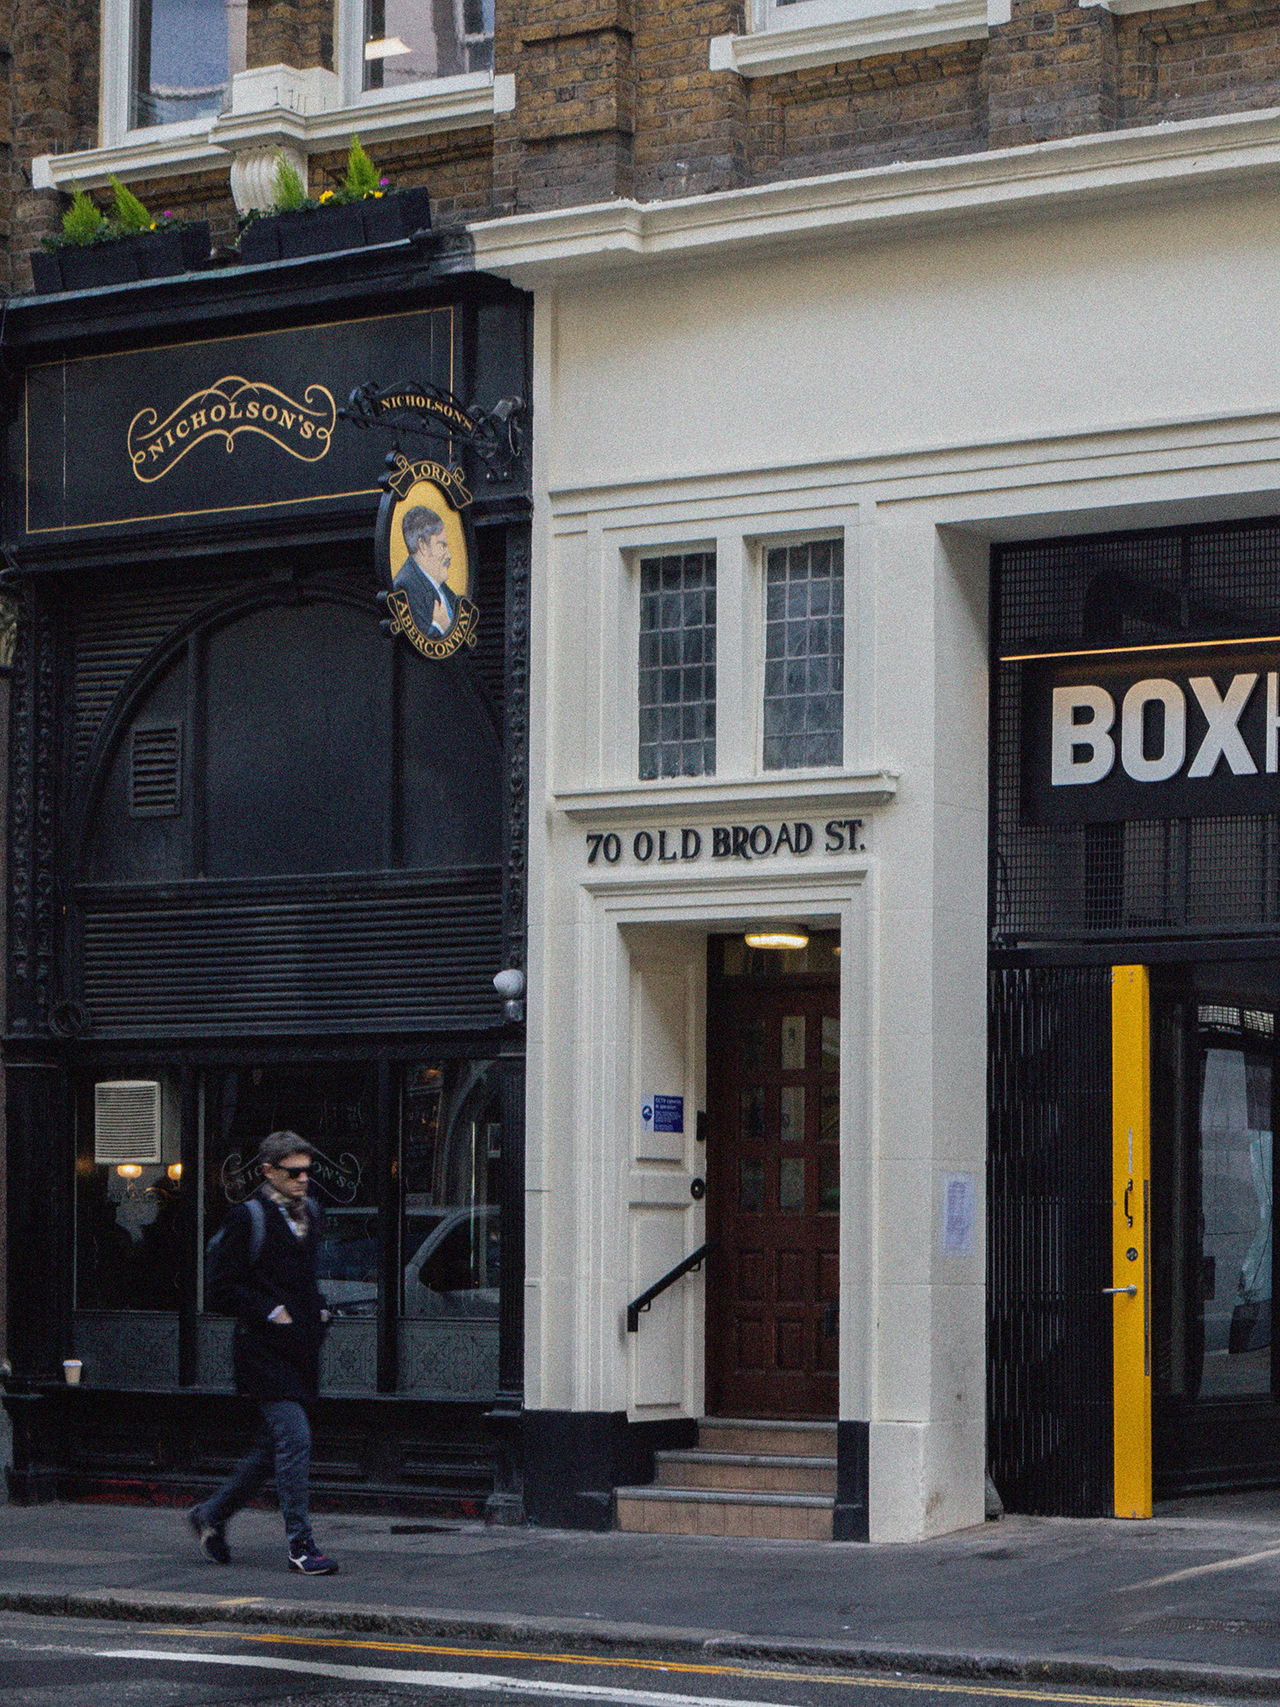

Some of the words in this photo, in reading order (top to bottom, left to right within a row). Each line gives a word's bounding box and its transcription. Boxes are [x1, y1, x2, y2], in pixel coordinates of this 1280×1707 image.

[147, 402, 315, 462] NICHOLSON'S
[381, 395, 472, 430] NICHOLSON'S
[410, 464, 451, 486] LORD
[396, 600, 469, 656] ABERCONWAY
[586, 833, 621, 865] 70
[633, 828, 702, 862] OLD
[712, 821, 813, 860] BROAD
[825, 819, 866, 852] ST.
[236, 1161, 347, 1189] NICON'S
